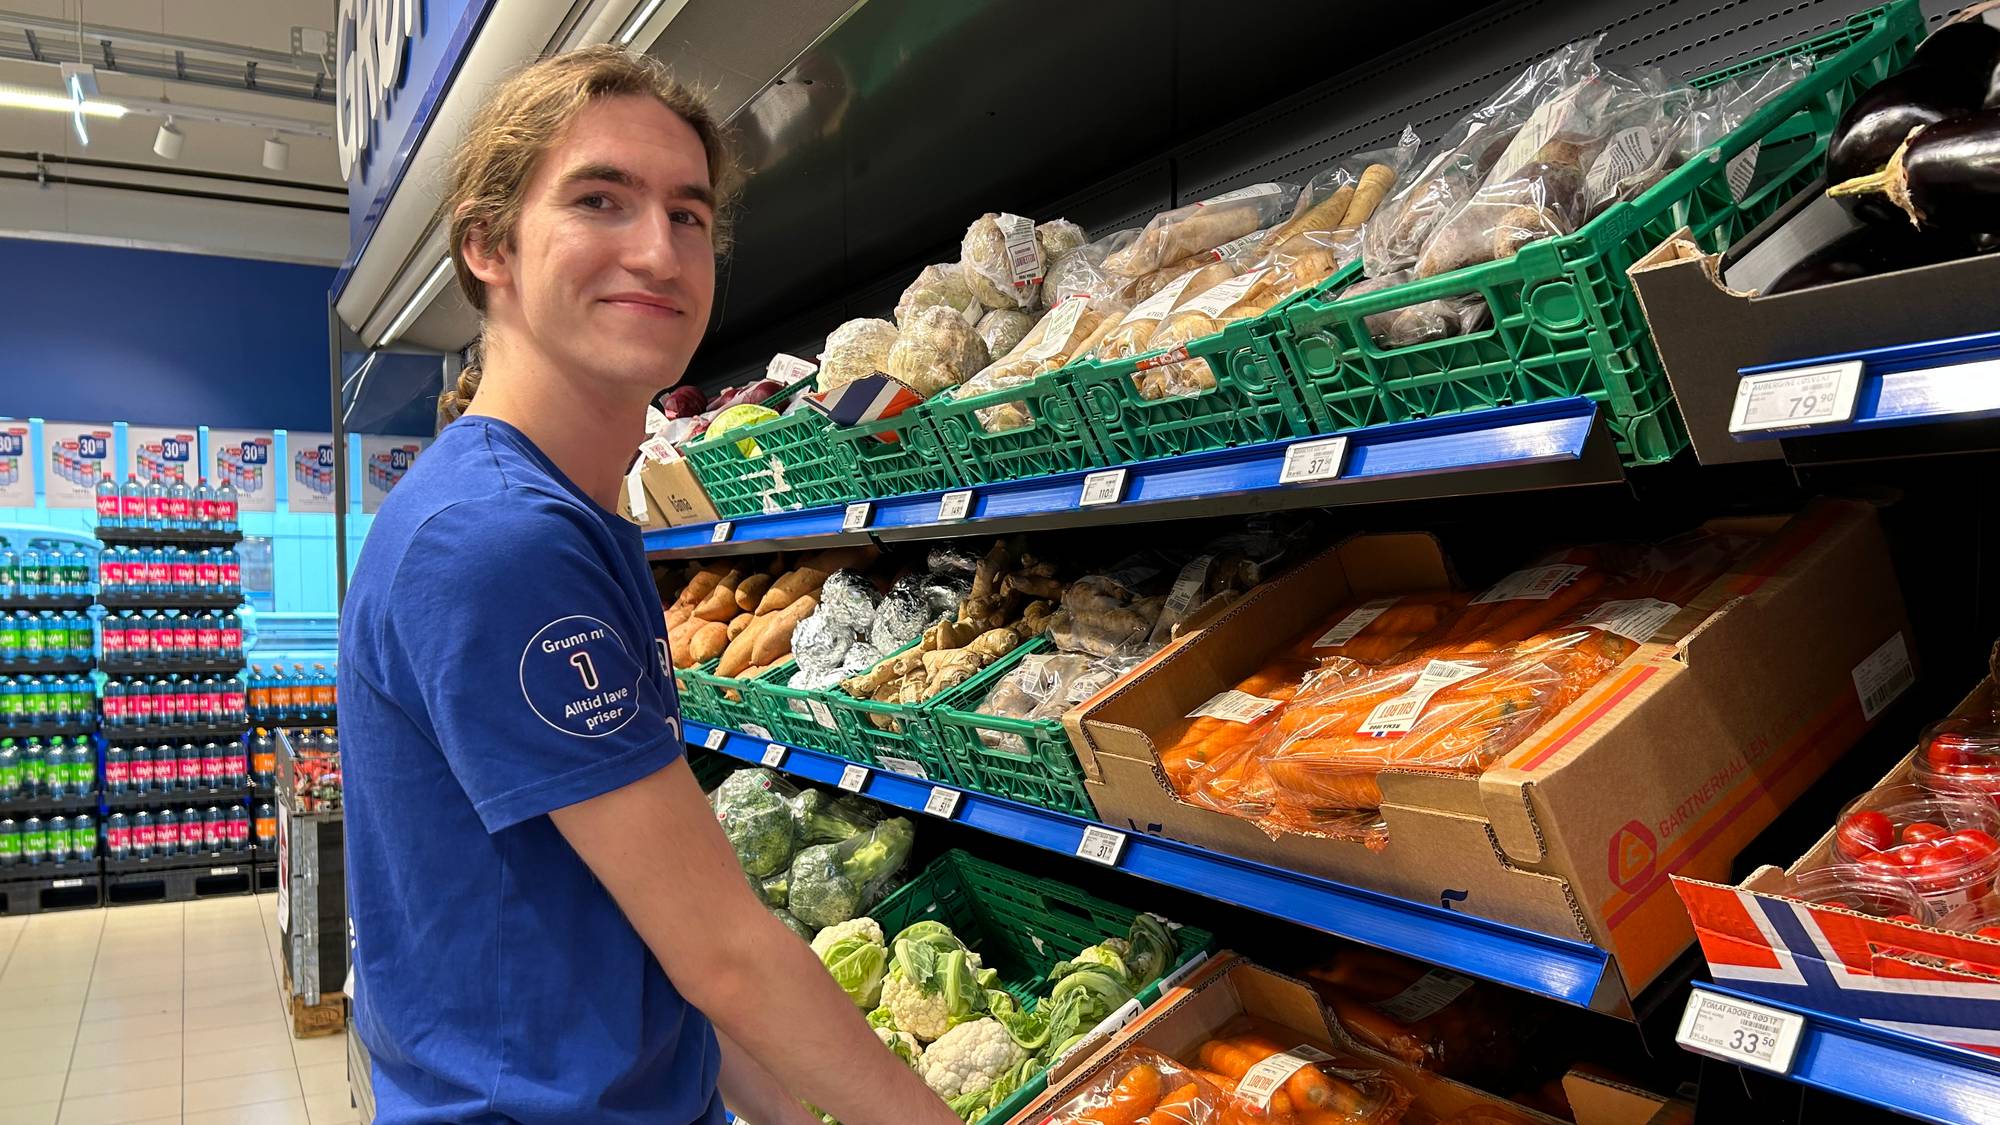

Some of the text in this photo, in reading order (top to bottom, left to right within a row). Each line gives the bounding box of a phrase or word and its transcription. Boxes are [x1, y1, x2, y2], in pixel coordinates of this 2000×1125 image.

[1788, 392, 1834, 418] 79 90
[80, 439, 96, 455] 30
[164, 442, 179, 459] 30
[243, 445, 257, 461] 30
[320, 448, 333, 463] 30
[392, 451, 406, 467] 30
[1308, 458, 1325, 474] 37
[541, 628, 605, 653] Grunn nr
[570, 651, 600, 690] 1
[564, 686, 628, 719] Alltid lave
[1377, 700, 1416, 719] GULROT
[585, 706, 624, 730] priser
[1658, 735, 1770, 839] GARTNERHALLEN
[1097, 845, 1108, 858] 31
[1702, 999, 1727, 1013] TOMAT
[1727, 1006, 1752, 1019] ADORE
[1752, 1012, 1769, 1023] RØD
[1729, 1029, 1775, 1054] 33 50
